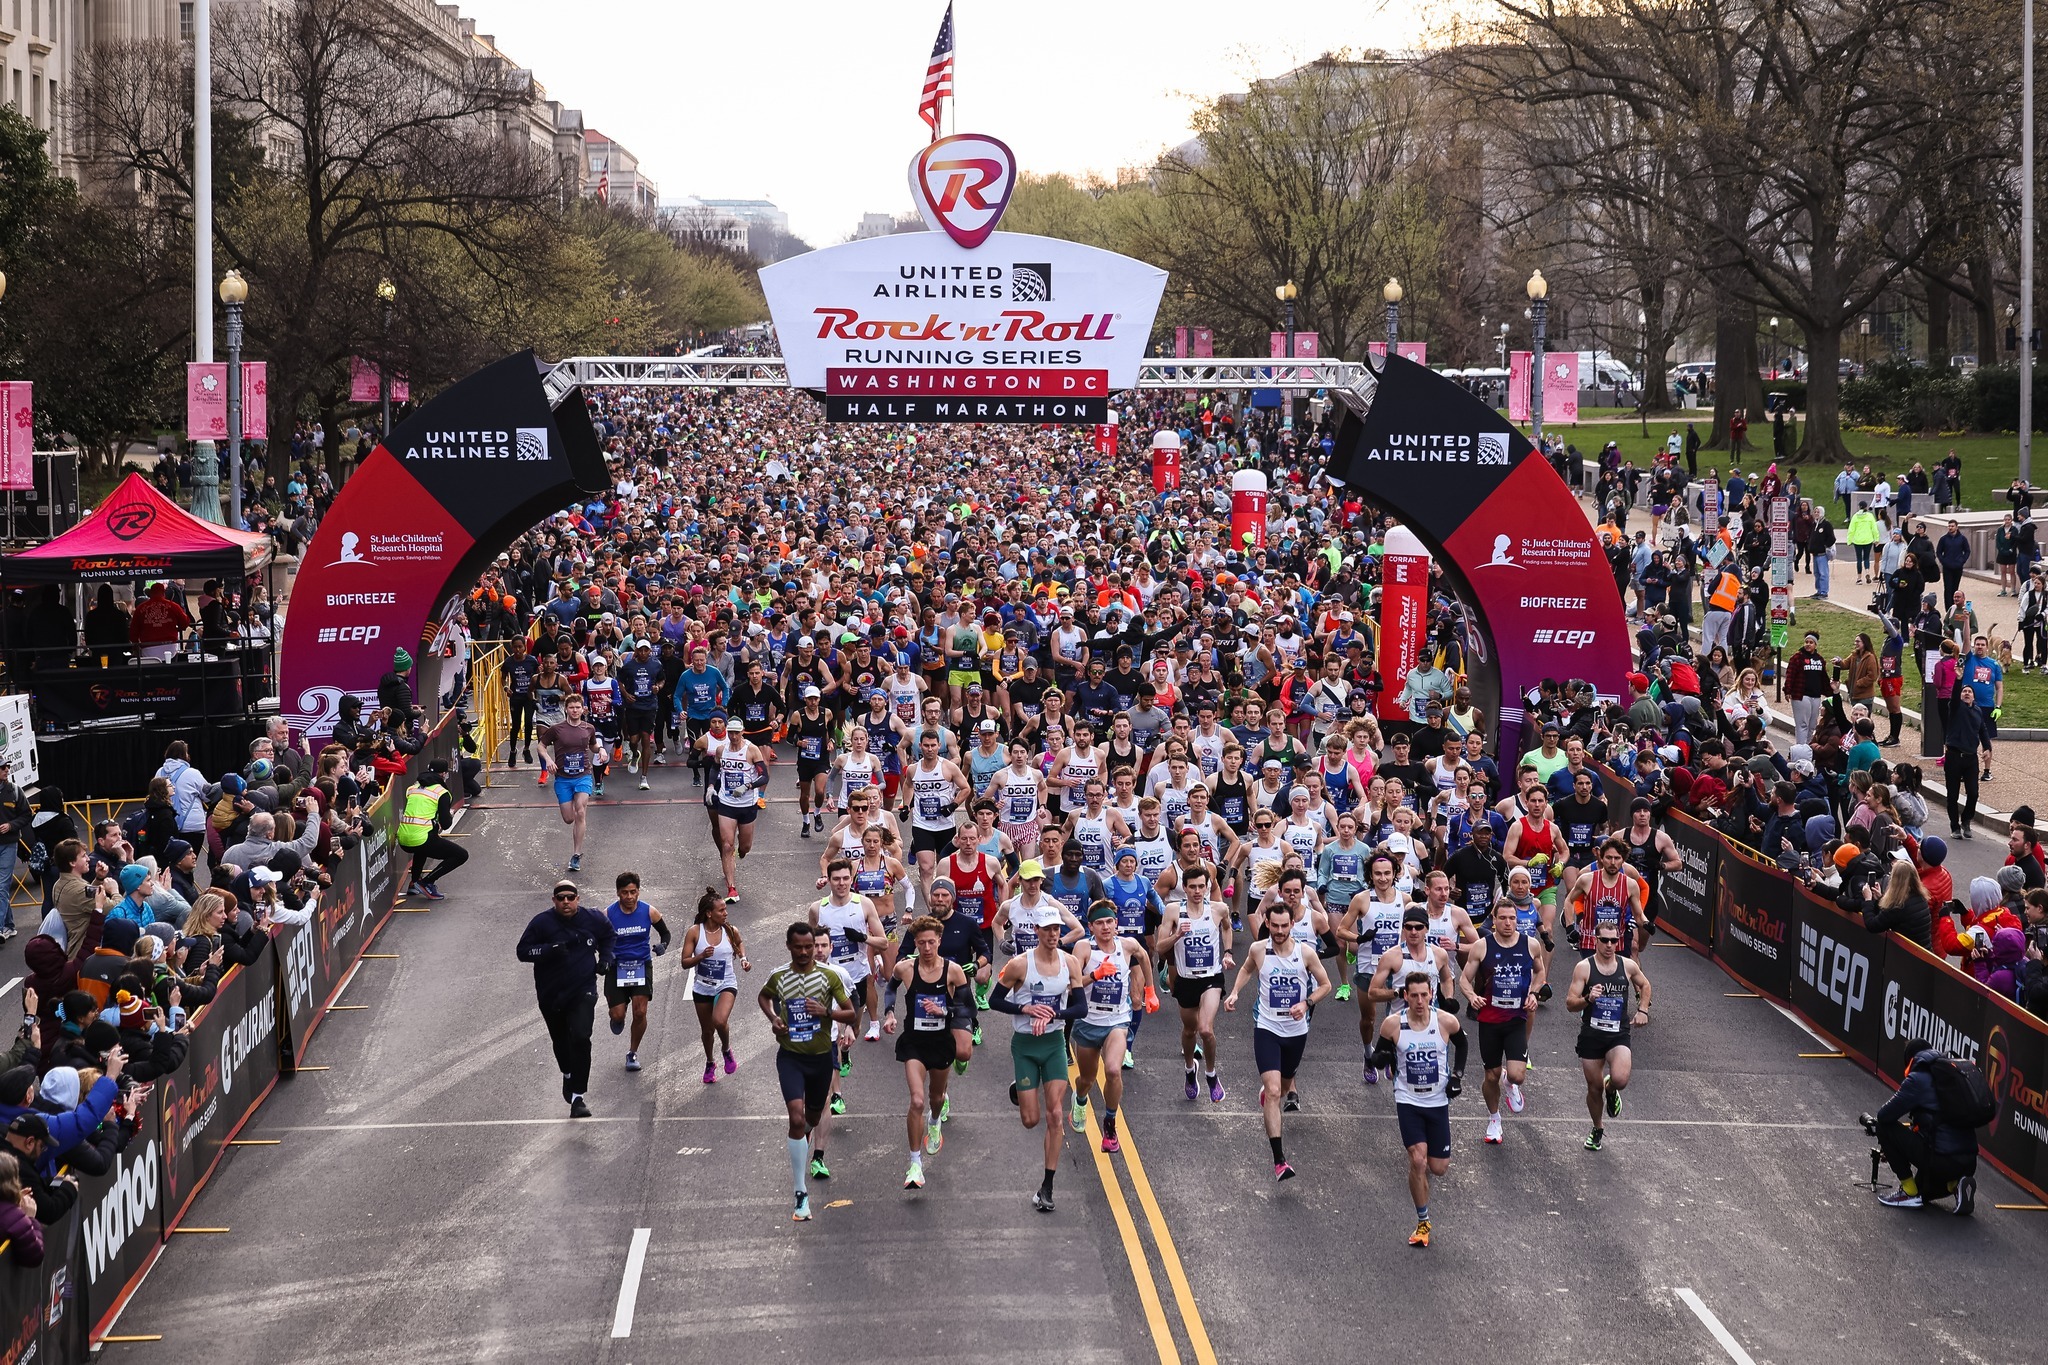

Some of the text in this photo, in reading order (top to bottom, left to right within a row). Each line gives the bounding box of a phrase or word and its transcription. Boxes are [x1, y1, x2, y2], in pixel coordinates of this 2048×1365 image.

[900, 266, 1002, 280] UNITED
[873, 284, 1002, 298] AIRLINES
[813, 307, 956, 341] Rock
[1000, 310, 1115, 341] Roll
[845, 349, 1081, 364] RUNNING SERIES
[839, 375, 1097, 389] WASHINGTON DC
[848, 403, 1087, 416] HALF MARATHON
[426, 431, 509, 444] UNITED
[1102, 428, 1110, 438] 3
[1389, 434, 1470, 446] UNITED
[406, 446, 510, 459] AIRLINES
[1166, 453, 1174, 464] 2
[1368, 449, 1470, 462] AIRLINES
[1252, 498, 1259, 512] 1
[370, 533, 442, 544] St. Jude Children's
[1521, 538, 1592, 550] St. Jude Children's
[371, 543, 442, 554] Research Hospital
[1522, 548, 1590, 560] Research Hospital
[71, 558, 119, 570] Rock
[134, 558, 172, 568] Roll
[80, 568, 164, 578] RUNNING SERIES
[1396, 564, 1408, 583] E
[1399, 596, 1411, 629] Roll
[339, 626, 381, 644] cep
[1553, 629, 1596, 649] cep
[1397, 644, 1410, 681] Rock
[721, 760, 744, 770] DOJO
[1069, 768, 1096, 776] DOJO
[916, 782, 942, 790] DOJO
[1078, 834, 1101, 843] GRC
[1140, 854, 1165, 866] GRC
[1686, 848, 1708, 875] Children's
[1686, 874, 1707, 898] Hospital
[1727, 890, 1786, 944] Rock Roll
[1374, 920, 1400, 930] GRC
[1184, 935, 1210, 946] GRC
[1730, 922, 1778, 961] RUNNING SERIES
[1270, 976, 1300, 986] GRC
[1818, 934, 1870, 1033] cep
[232, 985, 276, 1072] ENDURANCE
[1900, 997, 1980, 1065] ENDURANCE
[1406, 1050, 1438, 1062] GRC
[178, 1054, 219, 1132] Rock Roll
[182, 1096, 218, 1155] RUNNING SERIES
[82, 1138, 158, 1284] wahoo
